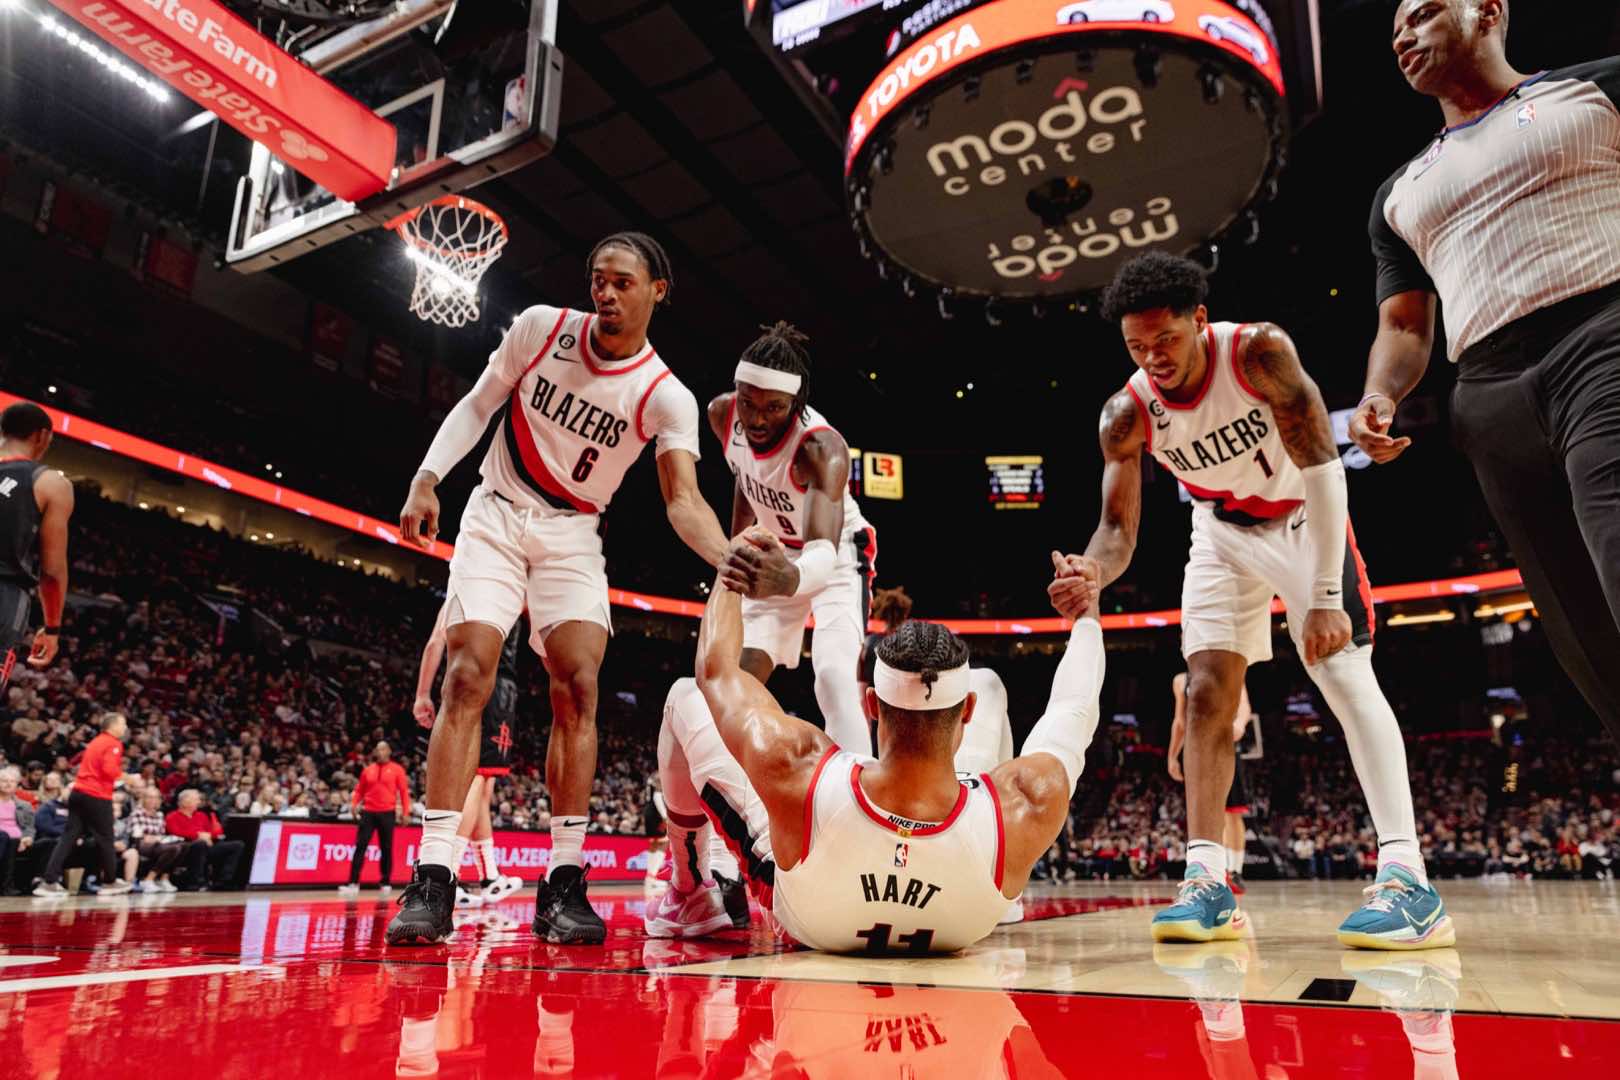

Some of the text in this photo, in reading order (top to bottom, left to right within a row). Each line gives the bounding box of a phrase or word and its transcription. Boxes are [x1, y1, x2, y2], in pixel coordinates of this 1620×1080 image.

[81, 3, 281, 134] State Farm
[199, 17, 278, 89] Farm
[867, 23, 981, 117] TOYOTA
[944, 118, 1147, 196] center
[987, 196, 1172, 260] center
[530, 374, 628, 449] BLAZERS
[1162, 408, 1269, 472] BLAZERS
[572, 447, 600, 483] 6
[1253, 447, 1274, 480] 1
[776, 514, 797, 536] 9
[888, 815, 912, 830] NIKE
[323, 844, 382, 862] TOYTA
[494, 848, 549, 867] BLAZER
[860, 873, 942, 910] HART
[856, 922, 935, 952] 11
